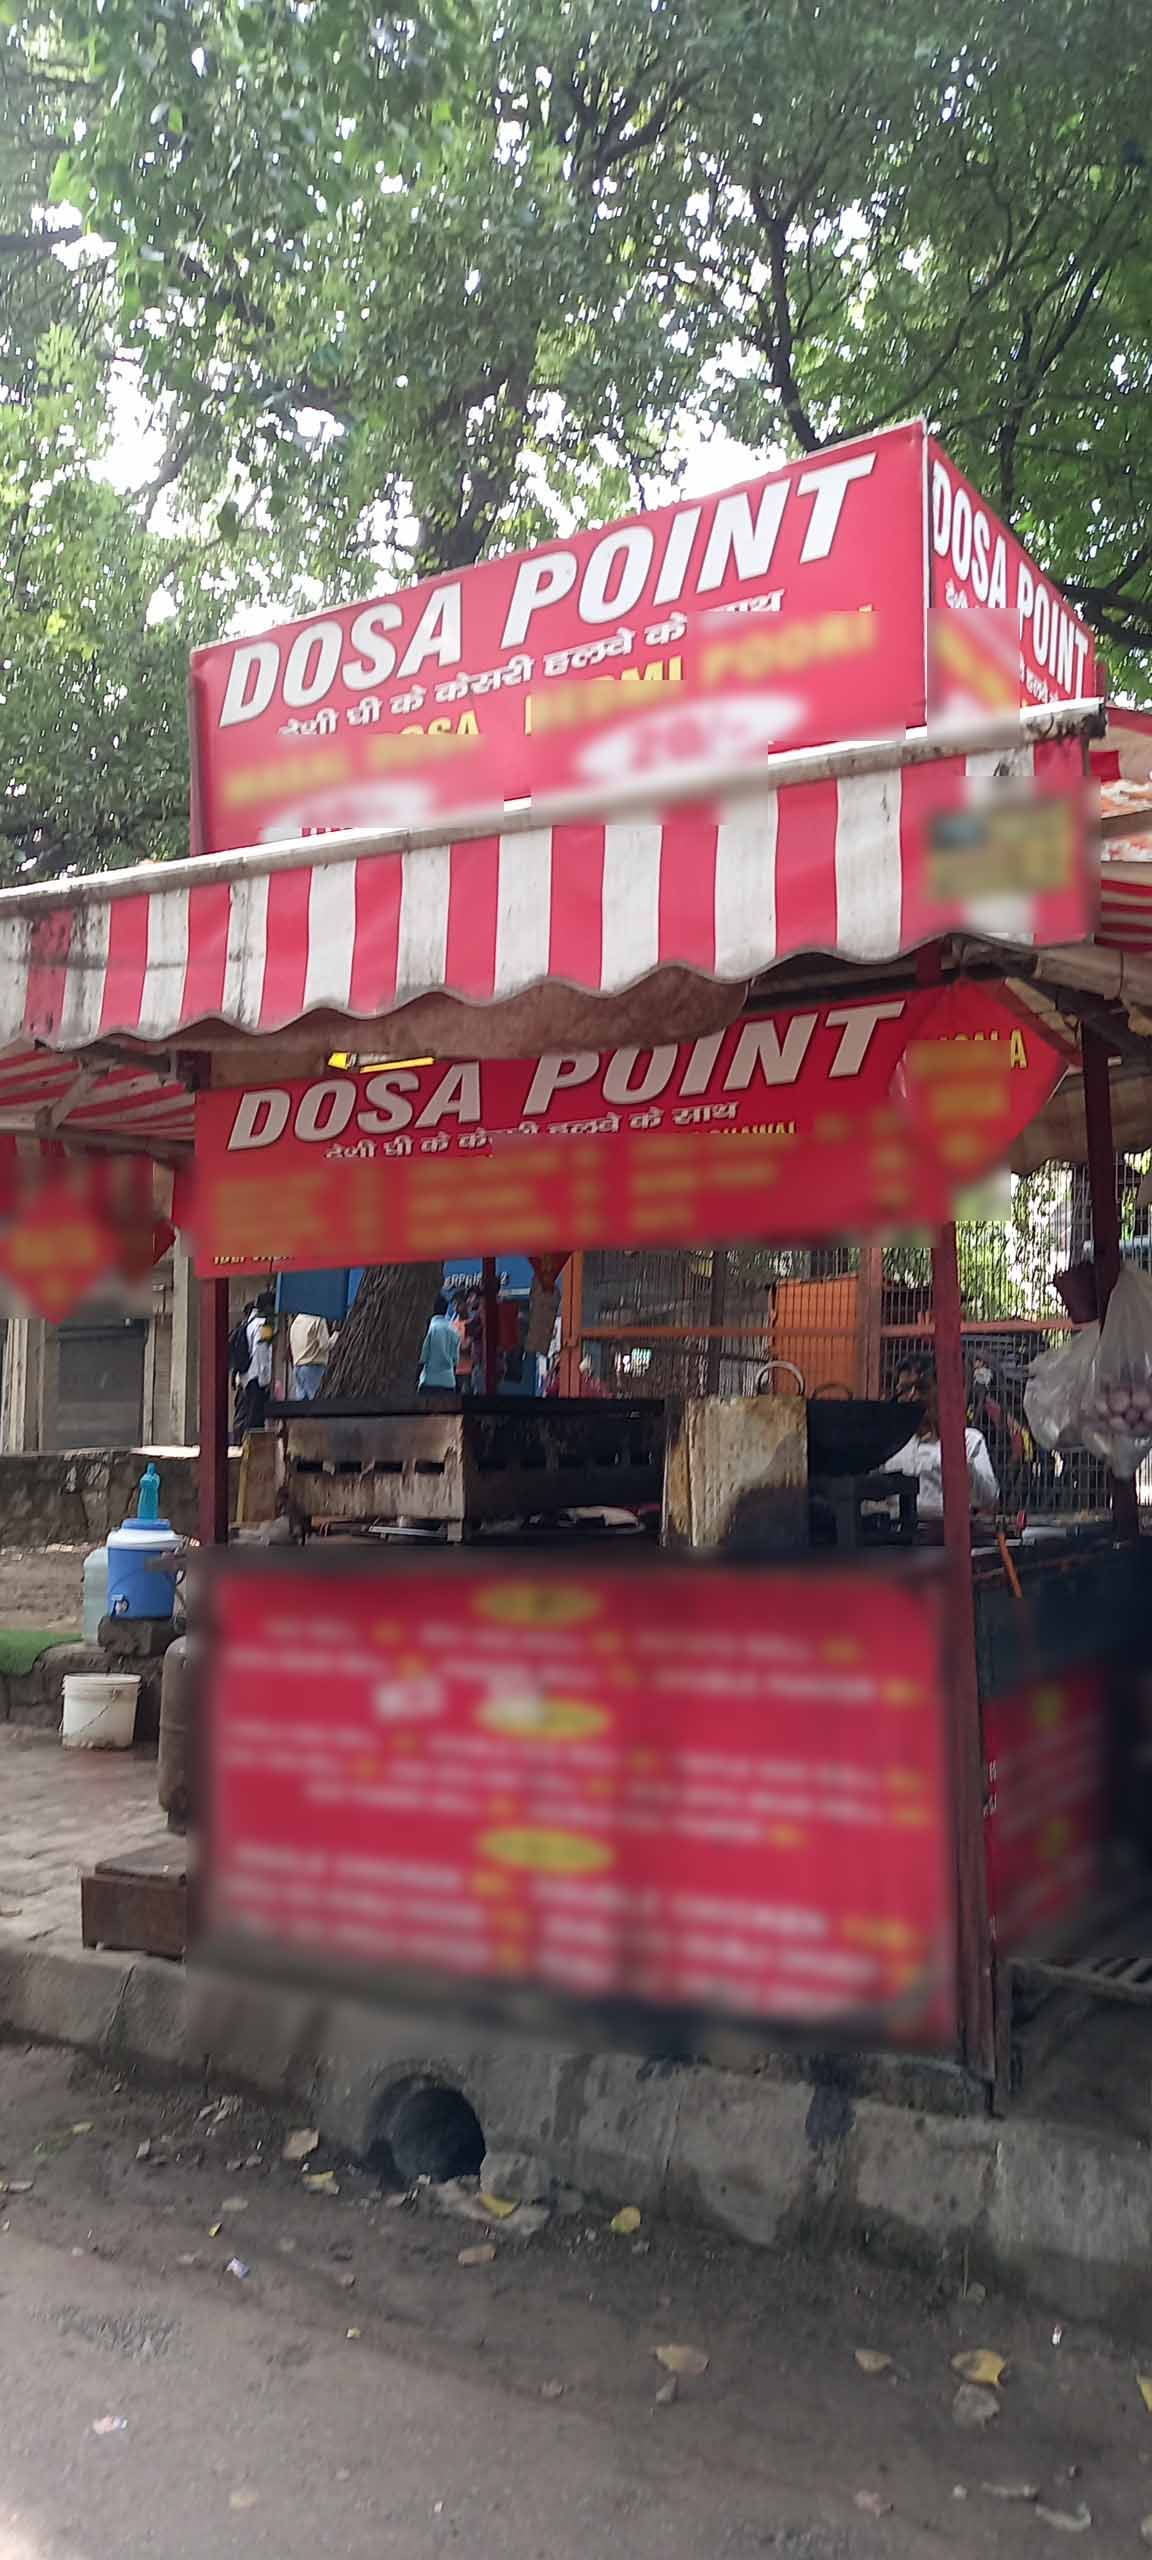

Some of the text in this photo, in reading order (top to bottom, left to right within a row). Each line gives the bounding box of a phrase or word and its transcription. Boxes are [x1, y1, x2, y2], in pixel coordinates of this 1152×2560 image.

[218, 451, 877, 729] DOSA POINT
[389, 684, 427, 715] के
[643, 611, 689, 647] के
[932, 459, 1007, 611] DOSA
[1017, 560, 1089, 700] POINT
[227, 1061, 482, 1152] DOSA
[522, 1000, 906, 1118] POINT
